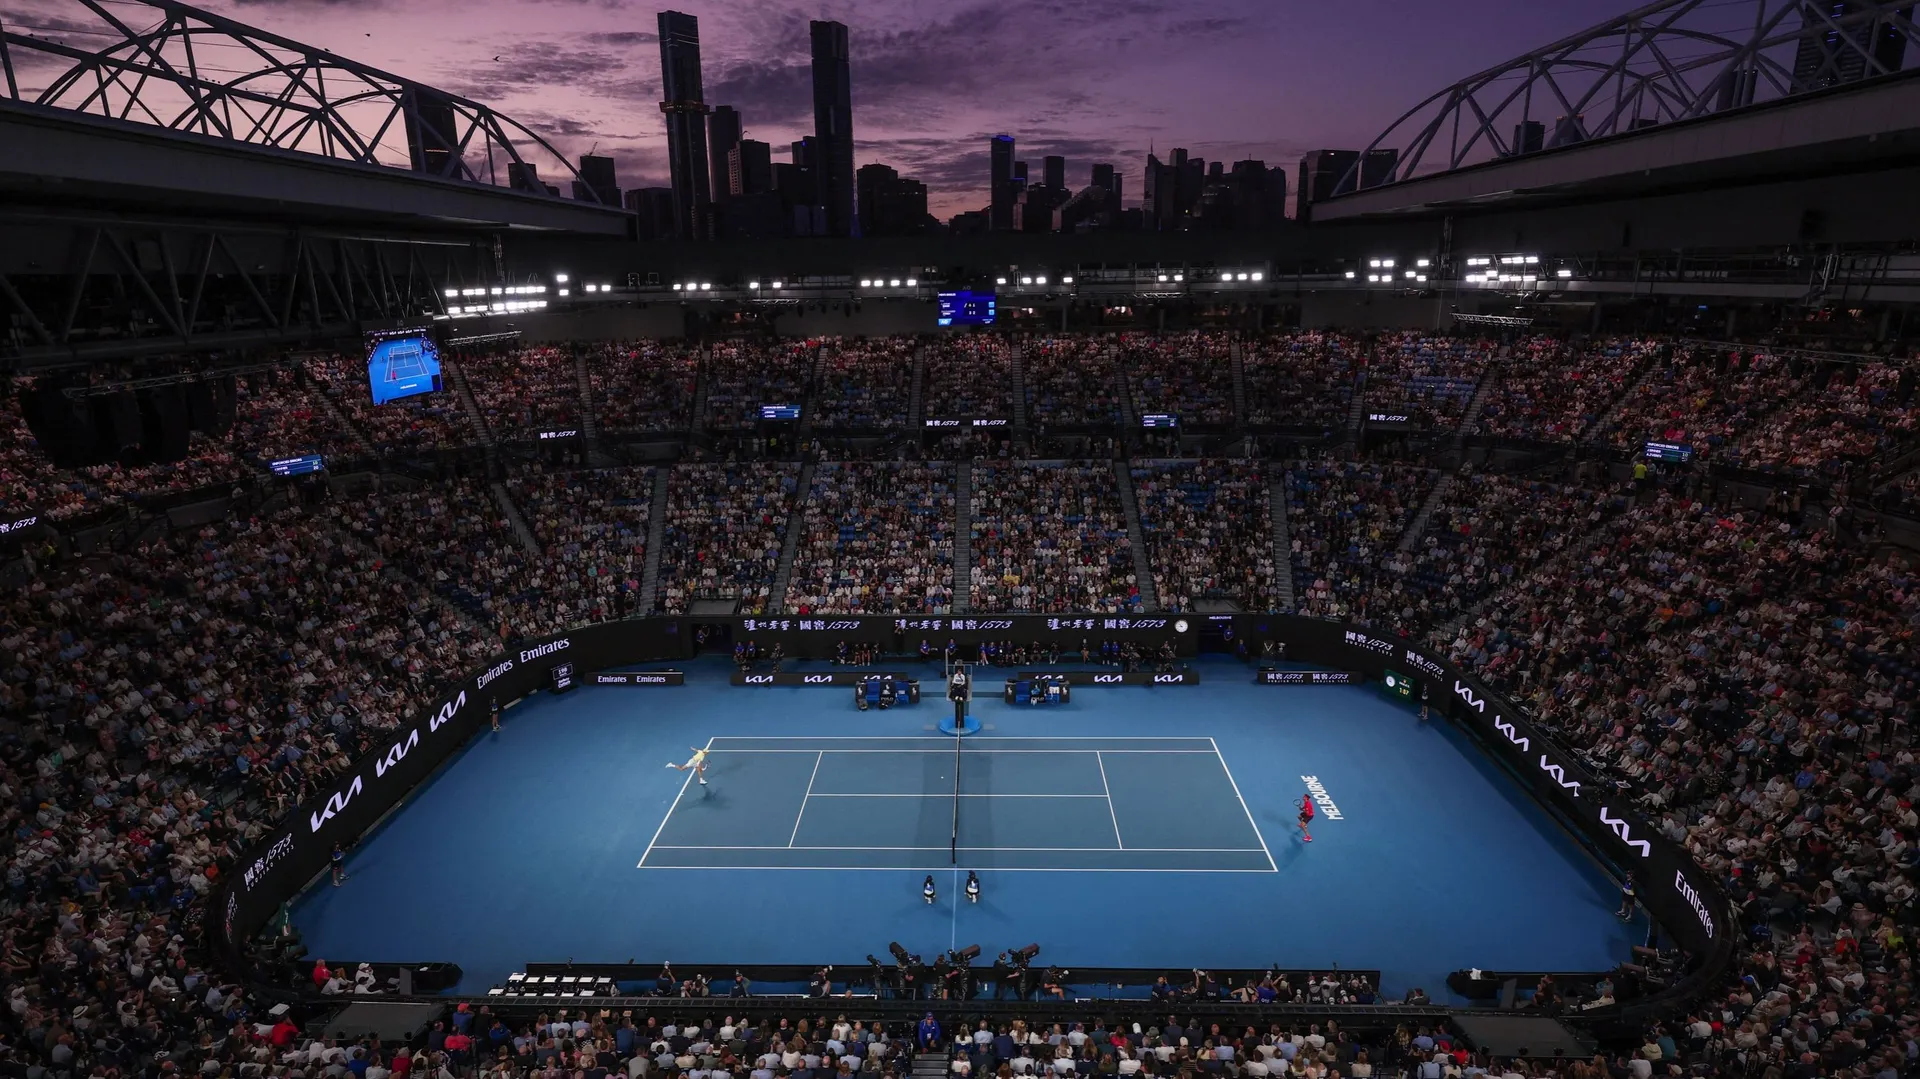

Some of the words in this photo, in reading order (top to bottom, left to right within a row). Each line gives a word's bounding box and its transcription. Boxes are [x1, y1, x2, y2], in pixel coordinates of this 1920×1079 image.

[520, 638, 570, 663] Emirates
[477, 658, 513, 690] Emirates
[1094, 674, 1123, 683] KIA
[1154, 674, 1183, 683] KIA
[430, 690, 466, 732] KIA
[1454, 680, 1484, 713] KIA
[376, 728, 418, 777] KIA
[1495, 715, 1530, 751] KIA
[1540, 754, 1580, 797] KIA
[310, 775, 362, 833] KIA
[1300, 775, 1344, 819] MELBOURNE
[1600, 807, 1650, 857] KIA
[1675, 869, 1714, 938] Emirates
